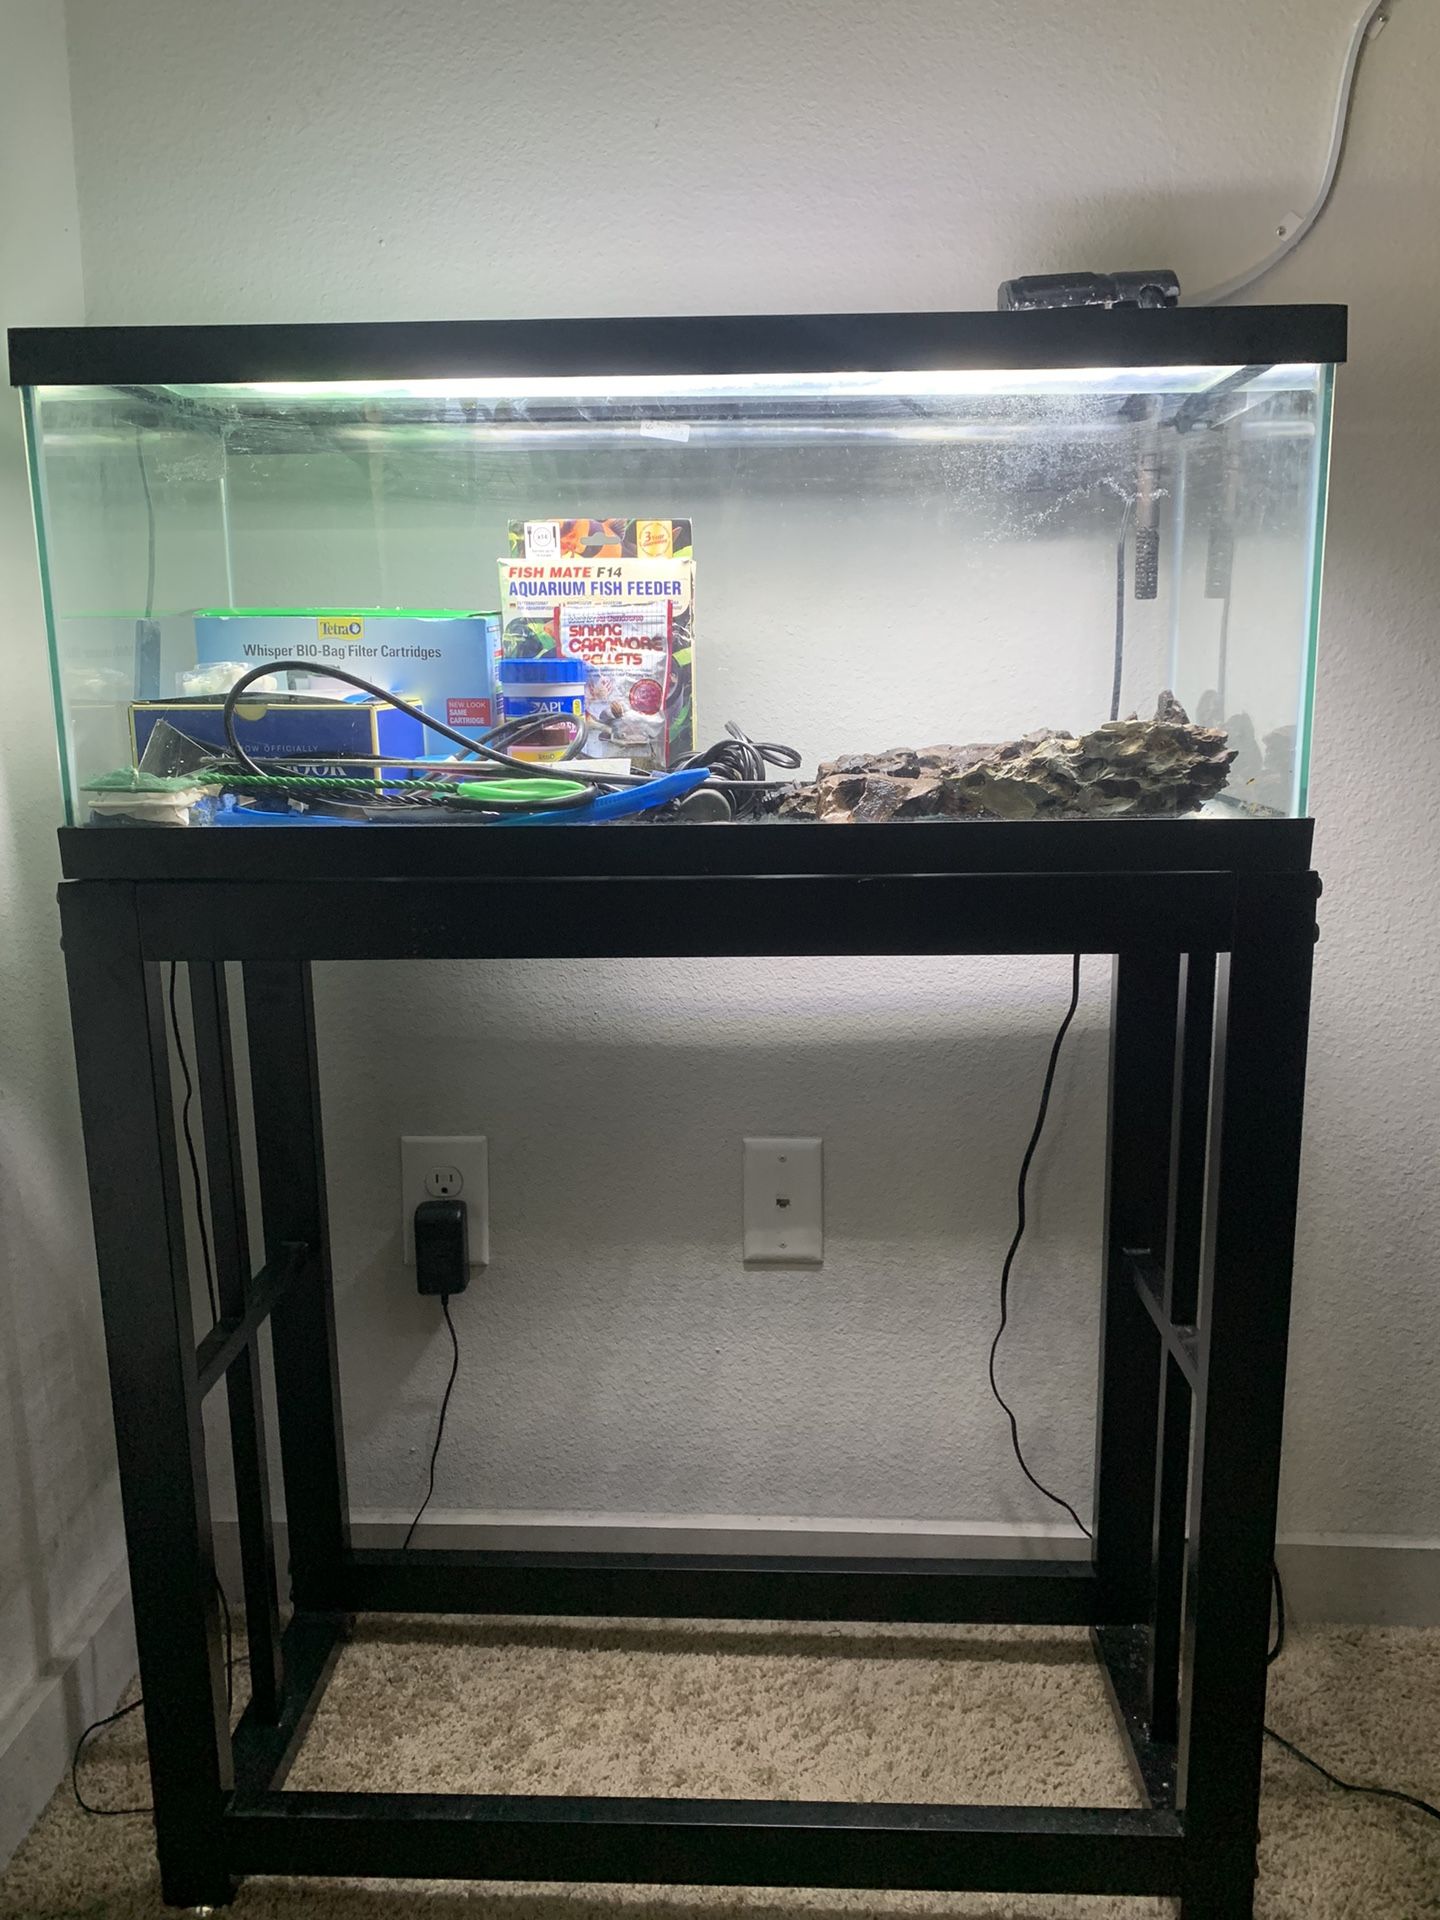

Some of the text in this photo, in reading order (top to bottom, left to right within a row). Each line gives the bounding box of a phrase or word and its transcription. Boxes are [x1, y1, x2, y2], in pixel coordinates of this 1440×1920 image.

[508, 566, 622, 578] FISH MATE F14
[509, 581, 682, 597] AQUARIUM FISH FEEDER
[320, 622, 350, 635] Tetra
[569, 623, 622, 637] SINKING
[568, 636, 663, 653] CARNIVORE
[243, 644, 442, 660] Whisper BIO-Bag Filter Cartridges
[582, 652, 643, 666] PELLETS
[449, 701, 487, 709] NEW LOOK
[538, 701, 562, 713] API
[449, 709, 468, 717] SAME
[449, 717, 485, 725] CARTRIDGE
[243, 744, 319, 752] OW OFFICIALLY
